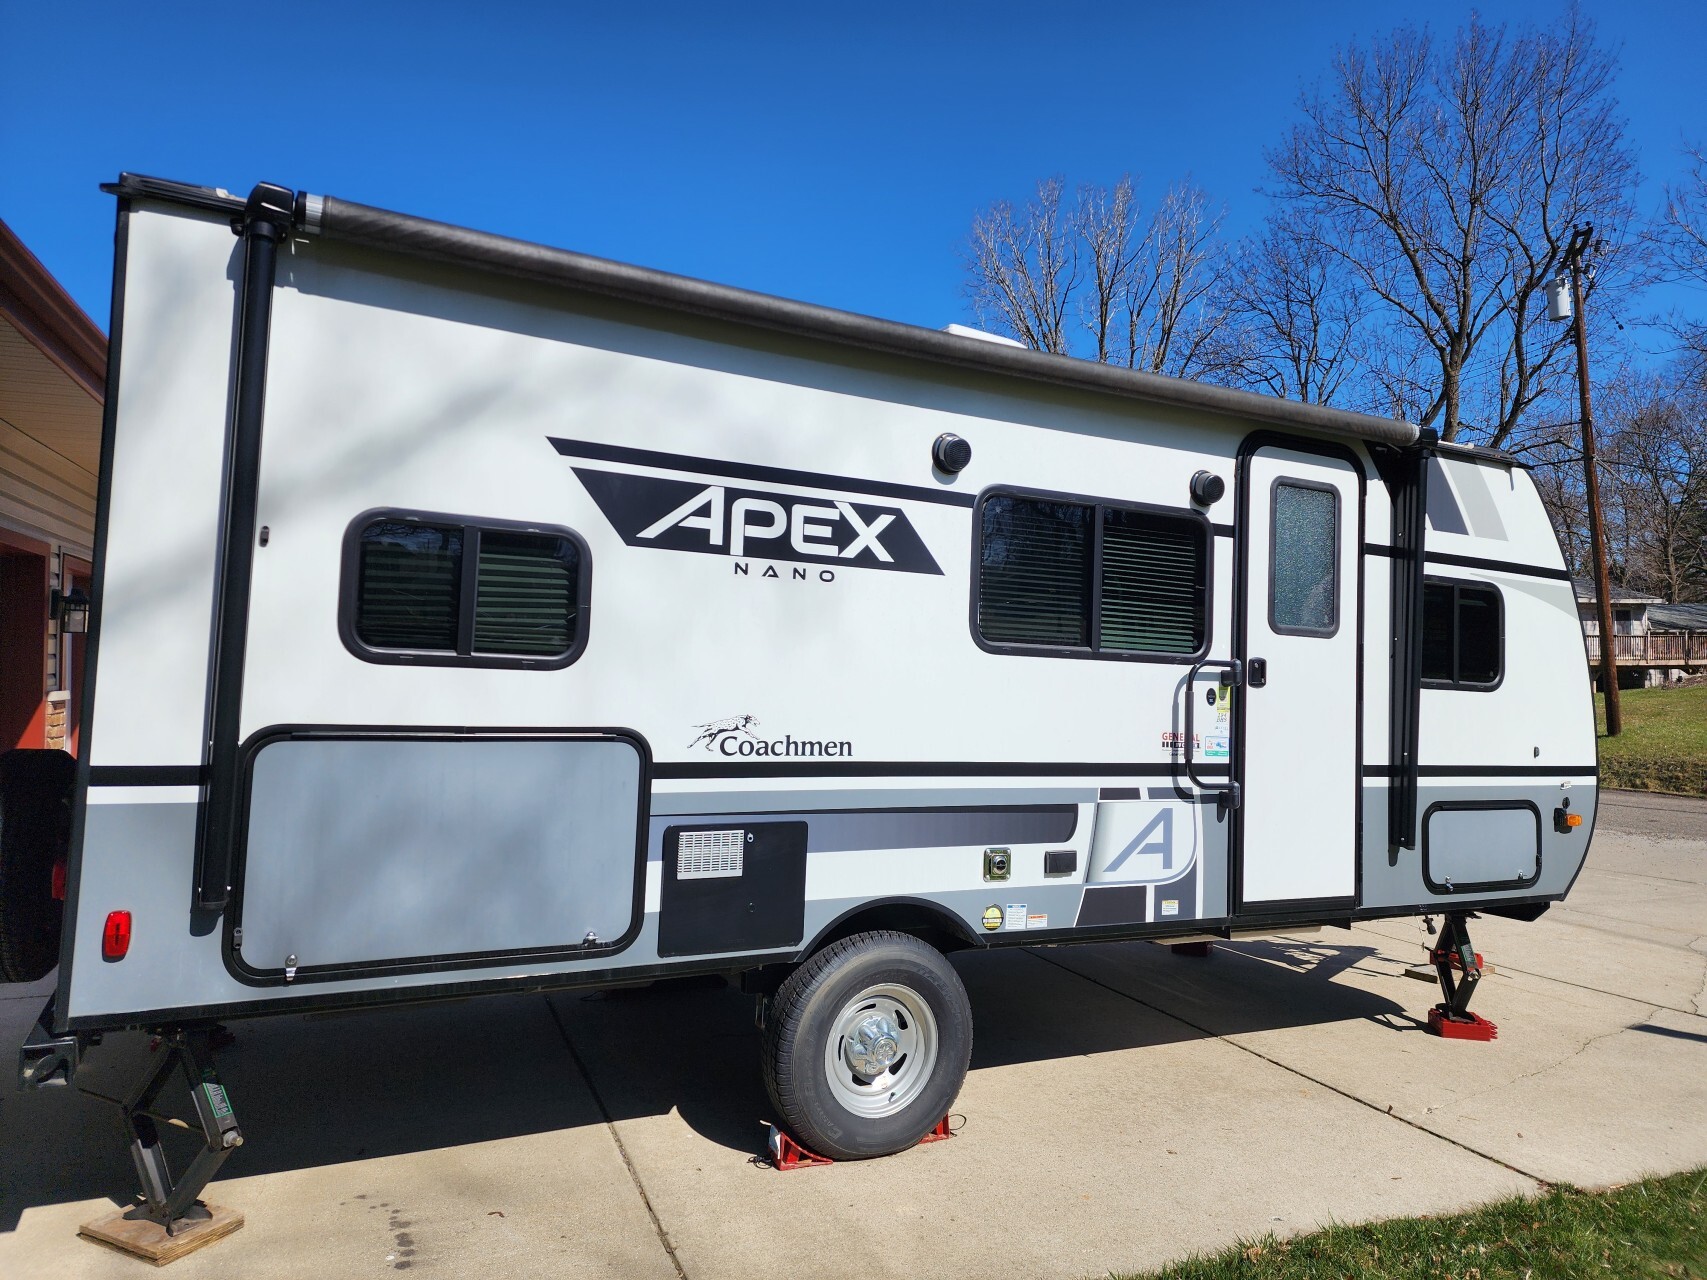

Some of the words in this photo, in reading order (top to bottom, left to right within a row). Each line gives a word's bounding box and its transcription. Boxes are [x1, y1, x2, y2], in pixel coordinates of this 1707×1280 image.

[635, 486, 897, 563] APEX
[734, 562, 836, 583] NANO
[719, 735, 853, 757] Coachmen
[1161, 732, 1200, 742] GENEAL
[1103, 807, 1173, 872] A
